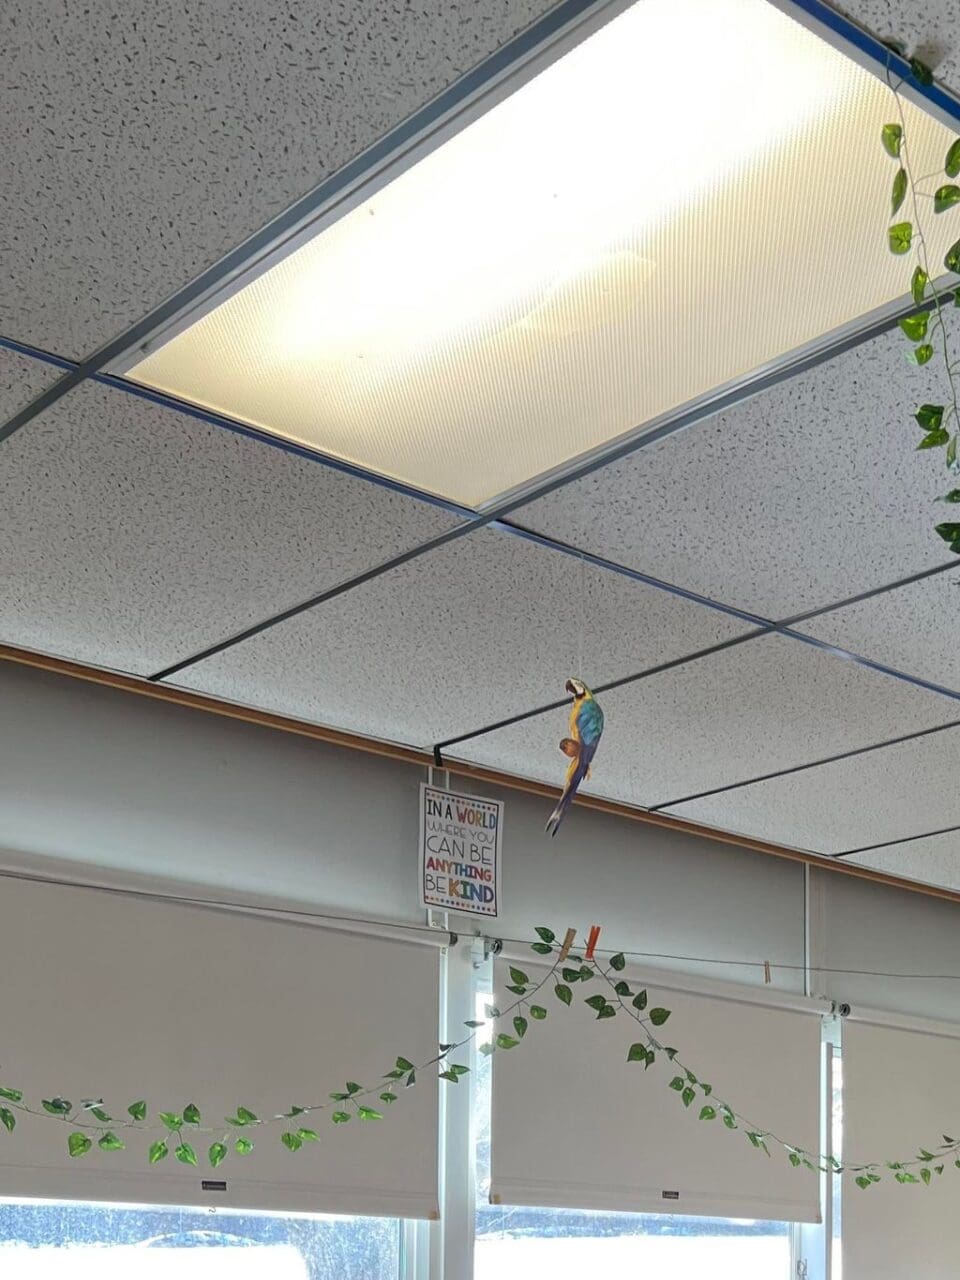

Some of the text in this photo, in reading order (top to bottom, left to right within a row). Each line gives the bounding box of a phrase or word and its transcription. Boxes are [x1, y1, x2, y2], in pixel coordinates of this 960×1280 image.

[427, 799, 496, 830] IN A WORLD
[427, 821, 495, 845] WHERE YOU
[427, 836, 493, 866] CAN BE
[425, 874, 494, 903] BE KIND
